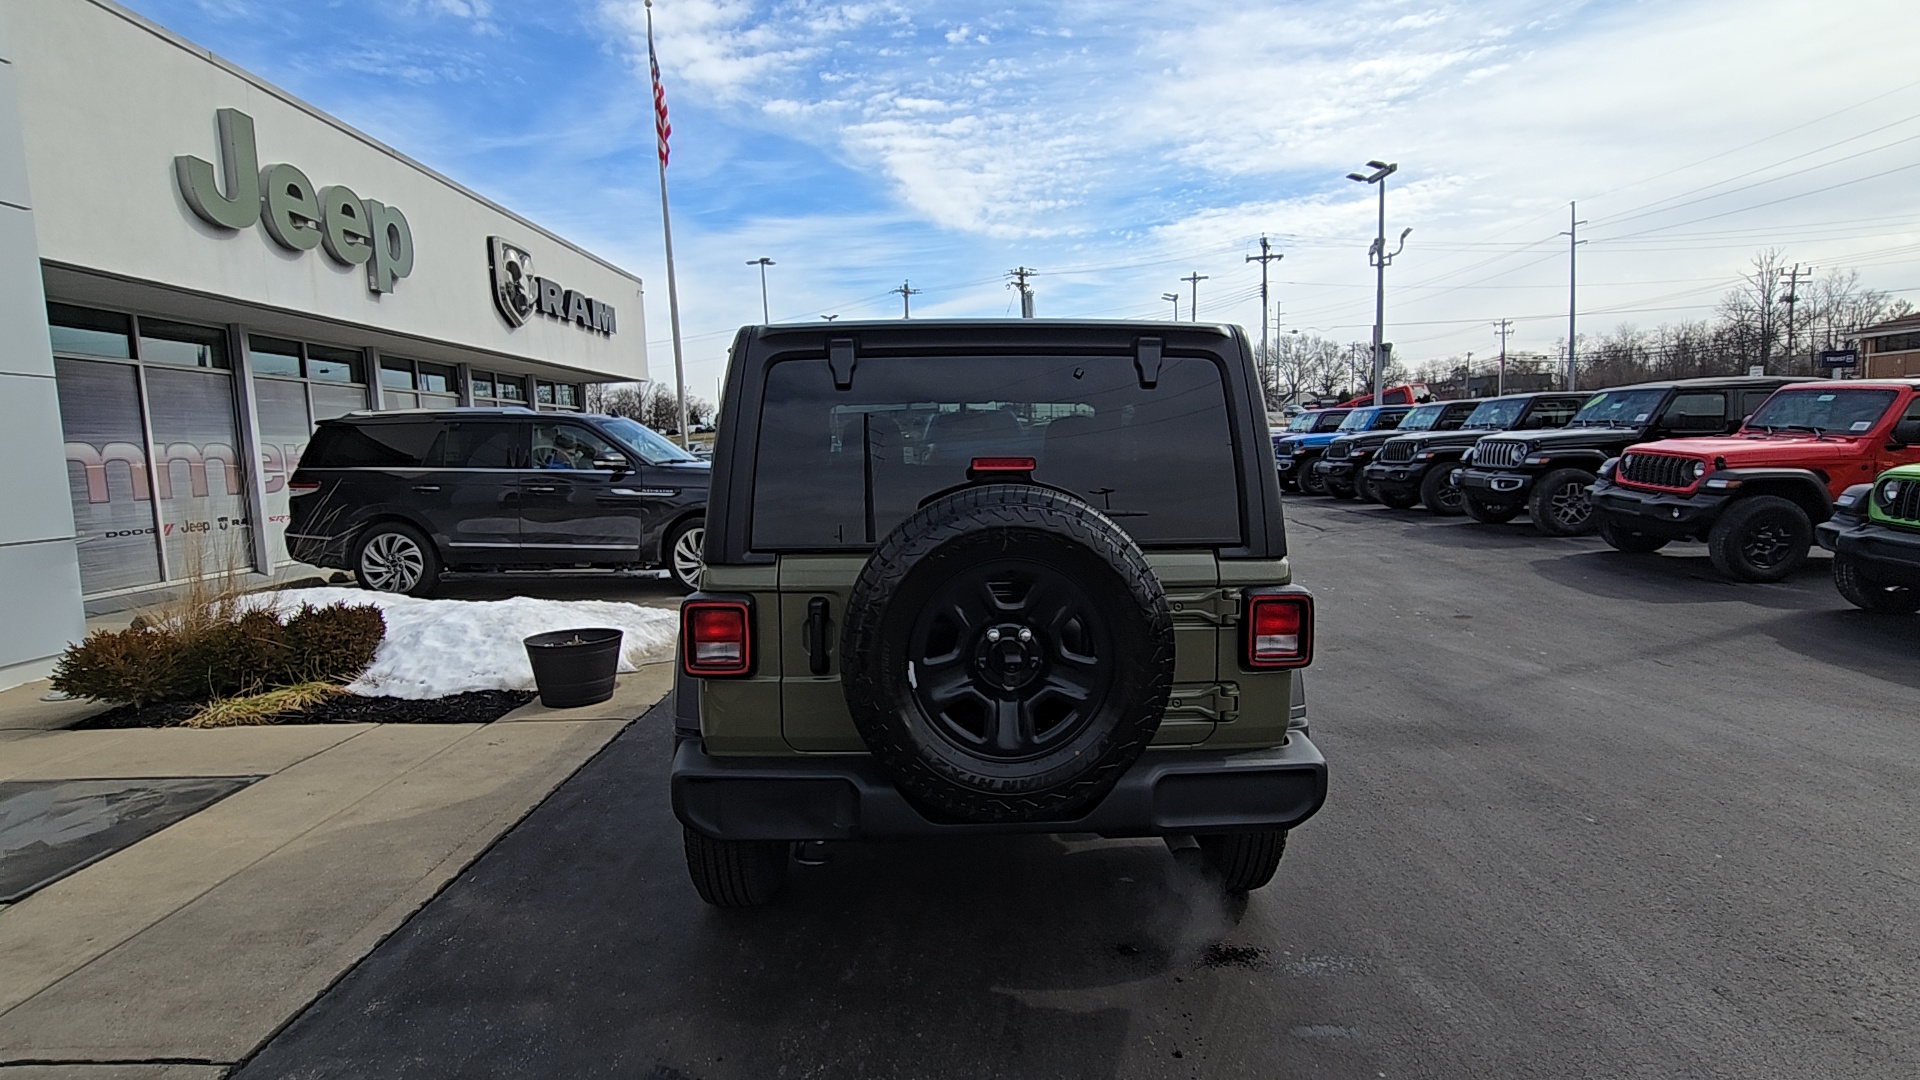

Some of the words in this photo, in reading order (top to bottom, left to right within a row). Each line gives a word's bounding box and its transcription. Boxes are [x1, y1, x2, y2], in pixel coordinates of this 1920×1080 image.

[175, 108, 414, 294] Jeep
[535, 277, 617, 334] RAM
[105, 528, 157, 538] DODG
[180, 519, 211, 534] Jeep
